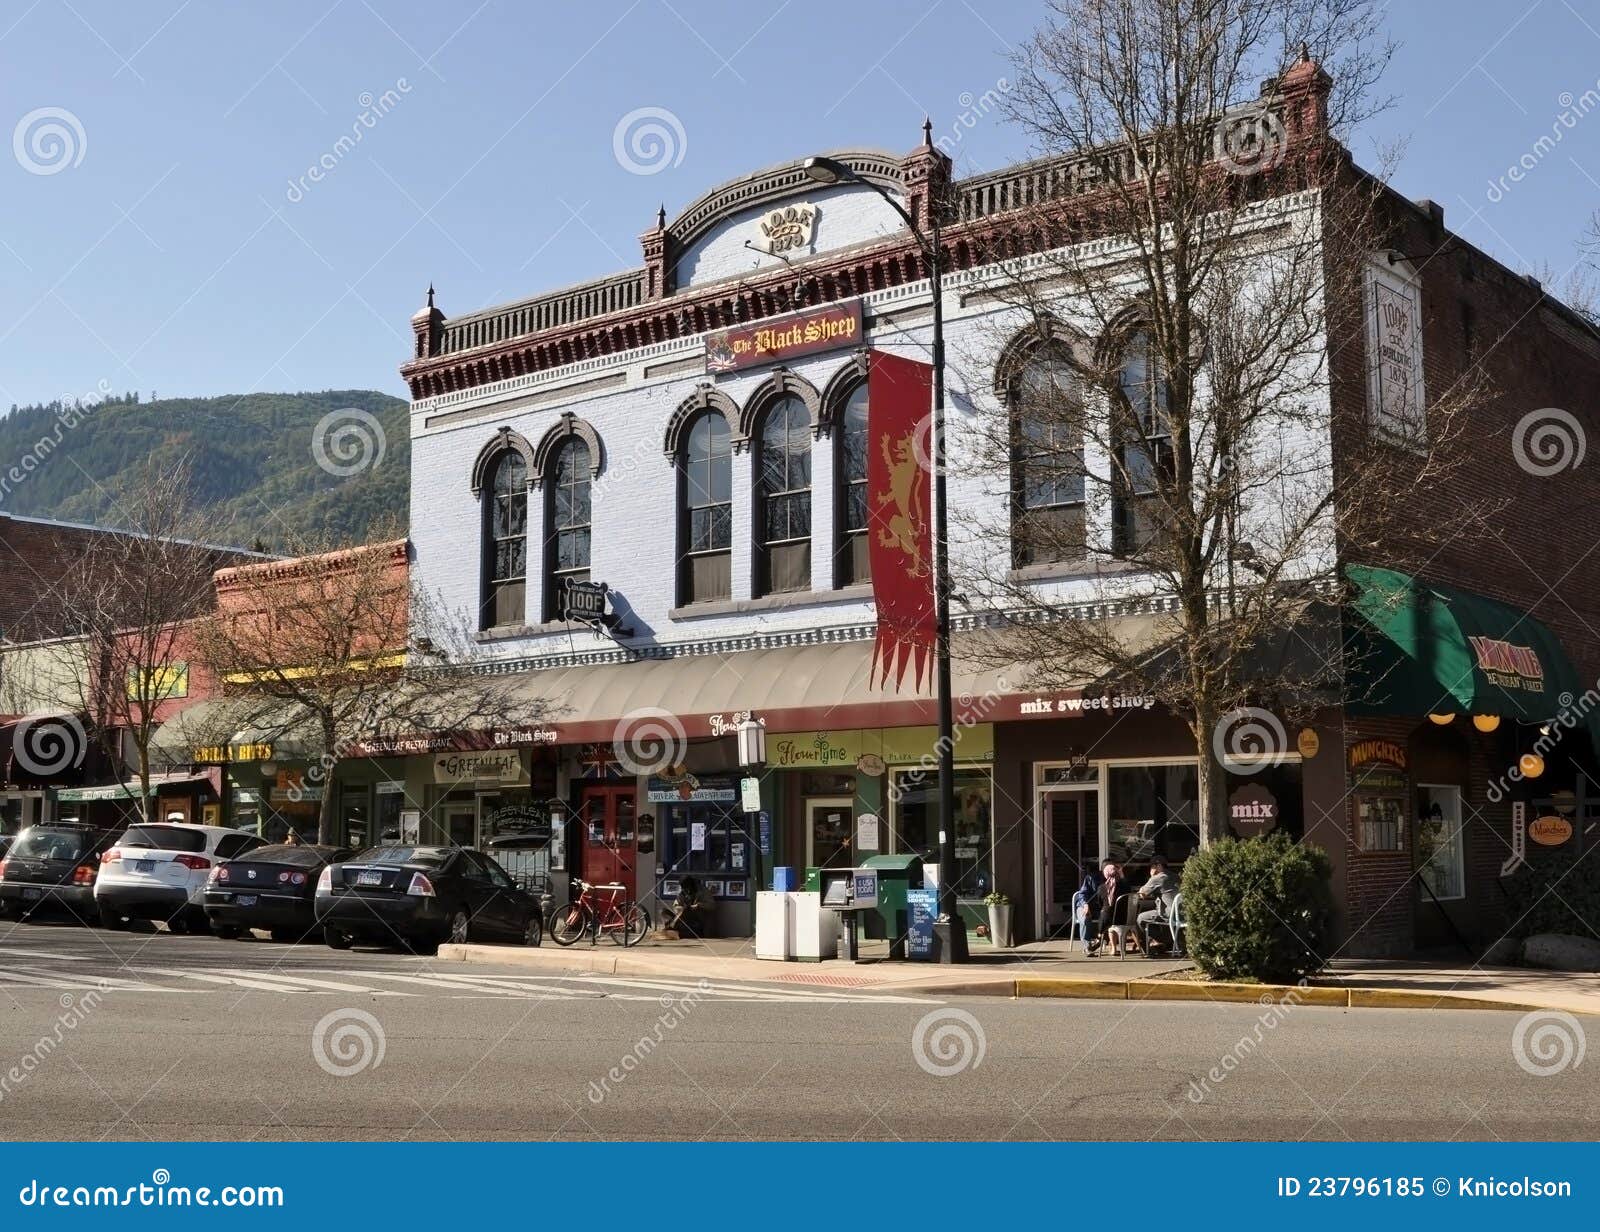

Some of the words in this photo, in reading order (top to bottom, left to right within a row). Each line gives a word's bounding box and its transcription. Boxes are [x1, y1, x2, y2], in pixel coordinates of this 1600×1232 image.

[733, 340, 752, 354] The
[754, 325, 803, 357] Black
[804, 316, 856, 343] Sheep
[571, 592, 603, 611] IOOF
[1020, 698, 1052, 714] mix
[1058, 695, 1109, 712] sweet
[1112, 693, 1155, 710] shop
[495, 732, 509, 745] The
[510, 730, 533, 743] Black
[534, 729, 558, 743] Sheep
[1351, 741, 1406, 768] MUNCHIES
[446, 755, 517, 777] GREENLEAF
[1231, 800, 1274, 818] mix
[862, 879, 874, 887] USA
